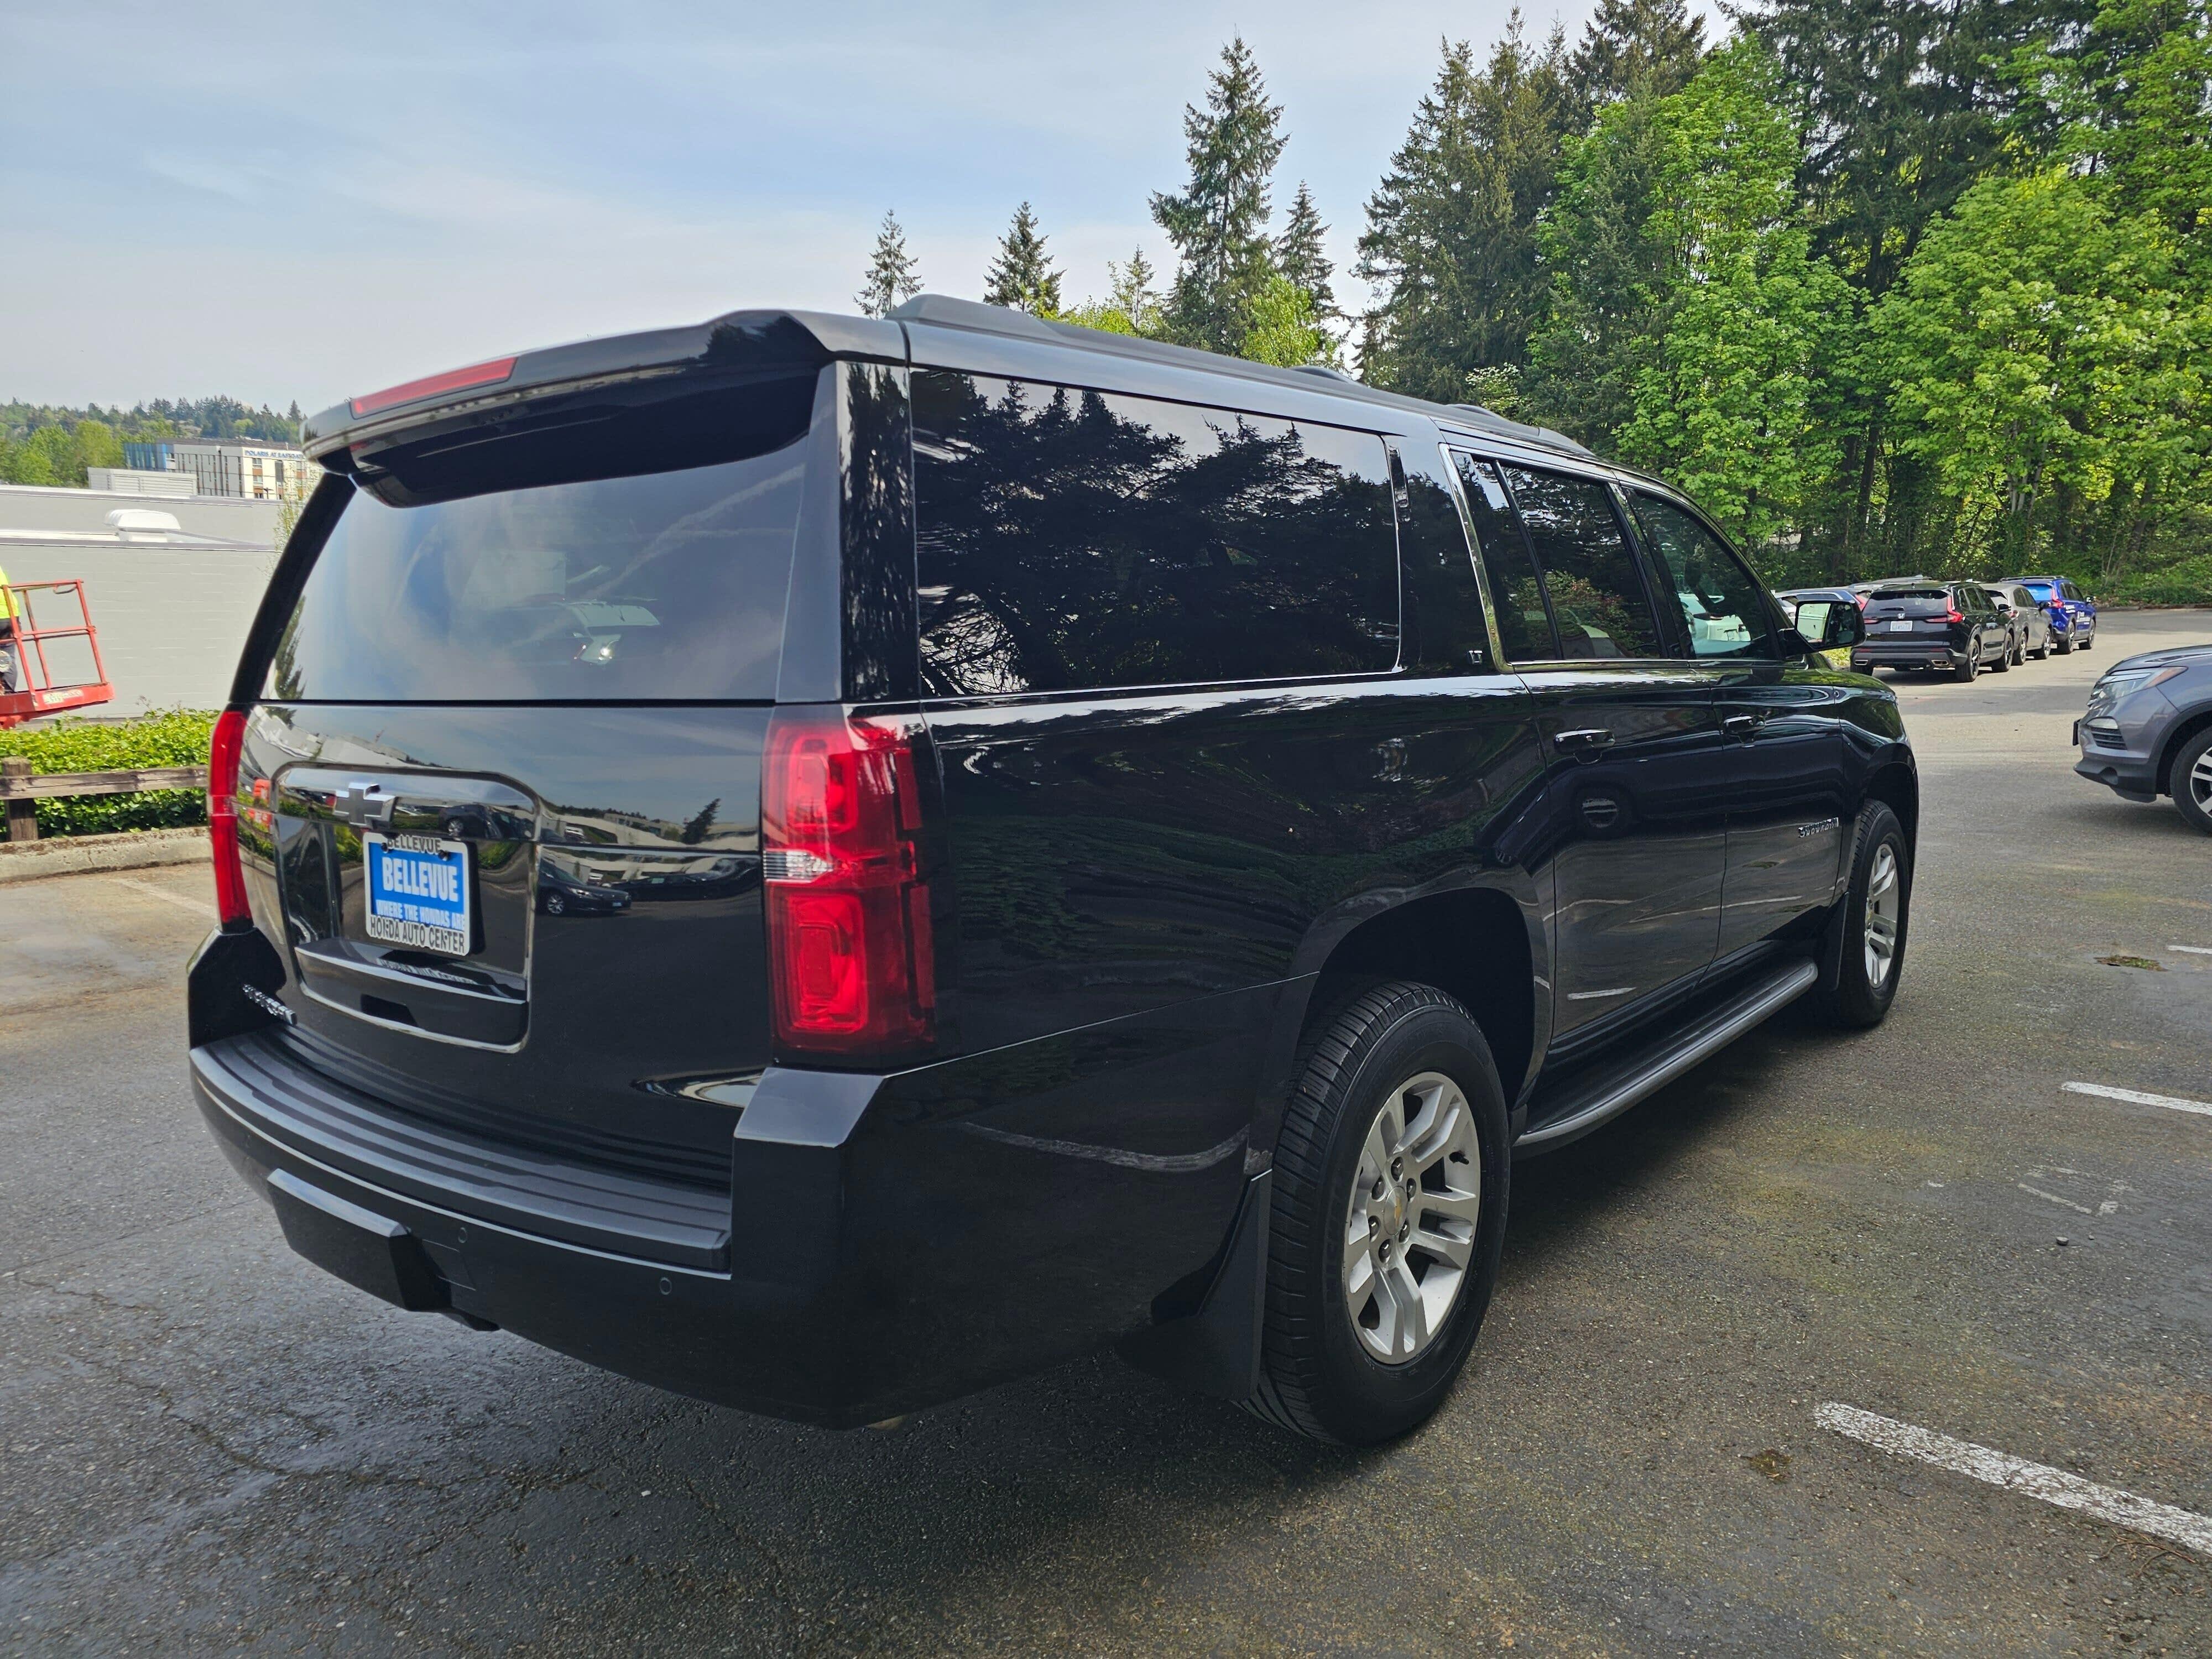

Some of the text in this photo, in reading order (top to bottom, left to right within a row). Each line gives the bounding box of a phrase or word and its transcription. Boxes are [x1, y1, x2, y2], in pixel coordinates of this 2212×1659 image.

[388, 837, 441, 853] BELLEVUE
[382, 857, 458, 902] BELLEVUE
[375, 899, 465, 931] WHERE THE HONDAS ARE
[371, 916, 465, 953] HONDA AUTO CENTER
